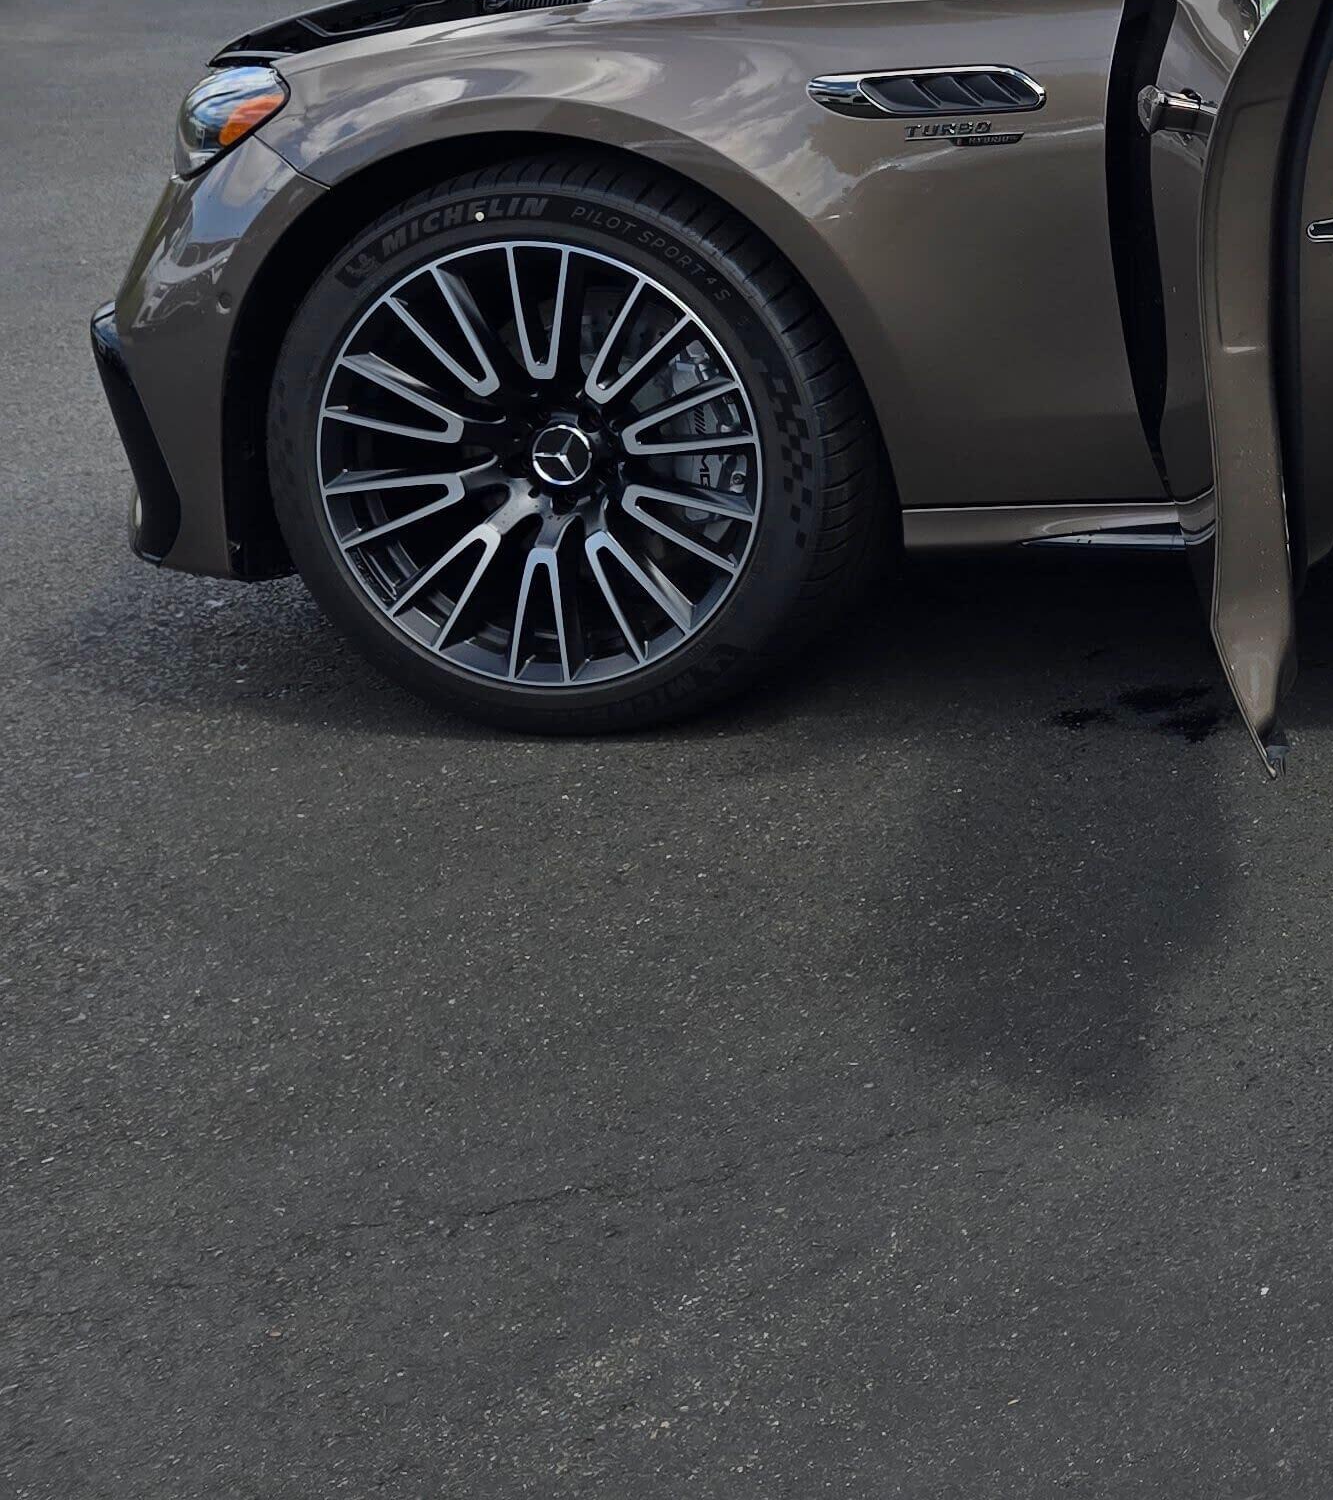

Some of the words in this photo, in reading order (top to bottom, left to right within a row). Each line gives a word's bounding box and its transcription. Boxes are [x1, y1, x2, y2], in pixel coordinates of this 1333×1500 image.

[904, 121, 992, 137] TURBO
[381, 197, 550, 257] MICHELIN
[570, 206, 637, 235] PILOT
[637, 230, 706, 276] SPORT
[714, 288, 732, 301] S
